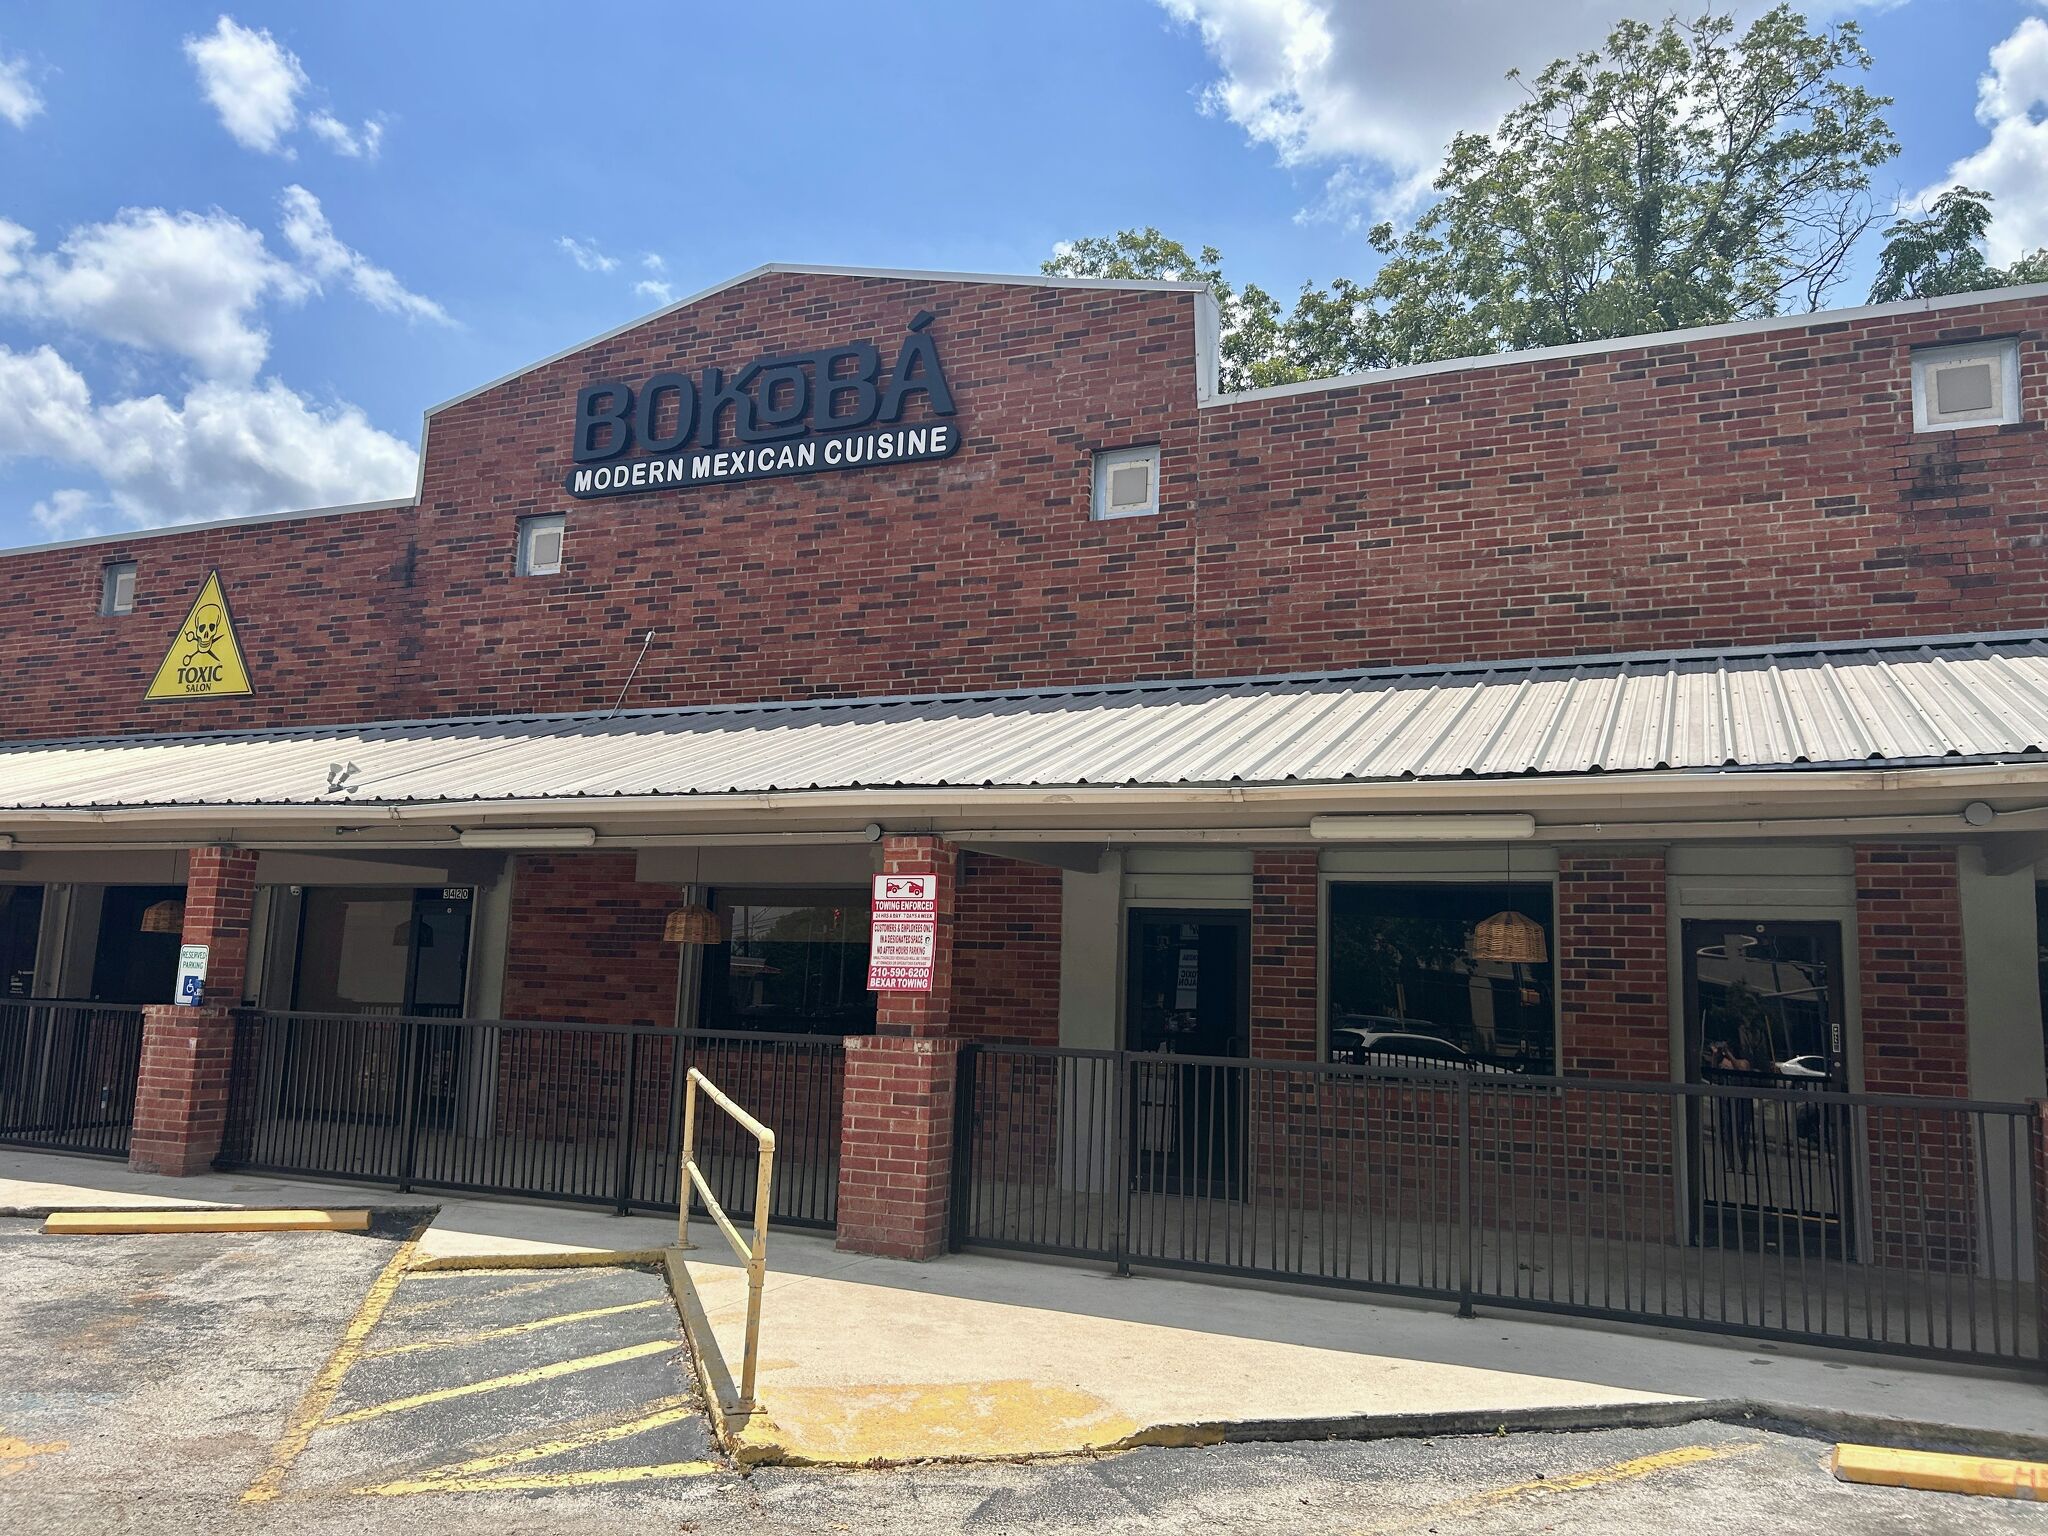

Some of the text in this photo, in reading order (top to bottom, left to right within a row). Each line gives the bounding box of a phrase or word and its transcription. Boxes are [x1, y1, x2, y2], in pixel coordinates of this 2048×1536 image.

[574, 425, 949, 492] MODERN MEXICAN CUISINE
[177, 665, 223, 684] TOXIC
[185, 683, 211, 692] SALON
[443, 889, 468, 899] 3420
[875, 901, 934, 911] TOWING ENFORCED
[874, 924, 896, 932] CUSTOMERS
[901, 924, 923, 932] EMPLOYEES
[923, 924, 933, 932] ONLY
[887, 935, 911, 944] DESIGNATED
[911, 935, 923, 944] SPACE
[182, 951, 207, 959] RESERVED
[877, 946, 926, 955] NO AFTER HOURS PARKING
[183, 961, 204, 969] PARKING
[871, 967, 929, 978] 210-590-6200
[870, 978, 928, 988] BEXAR TOWING
